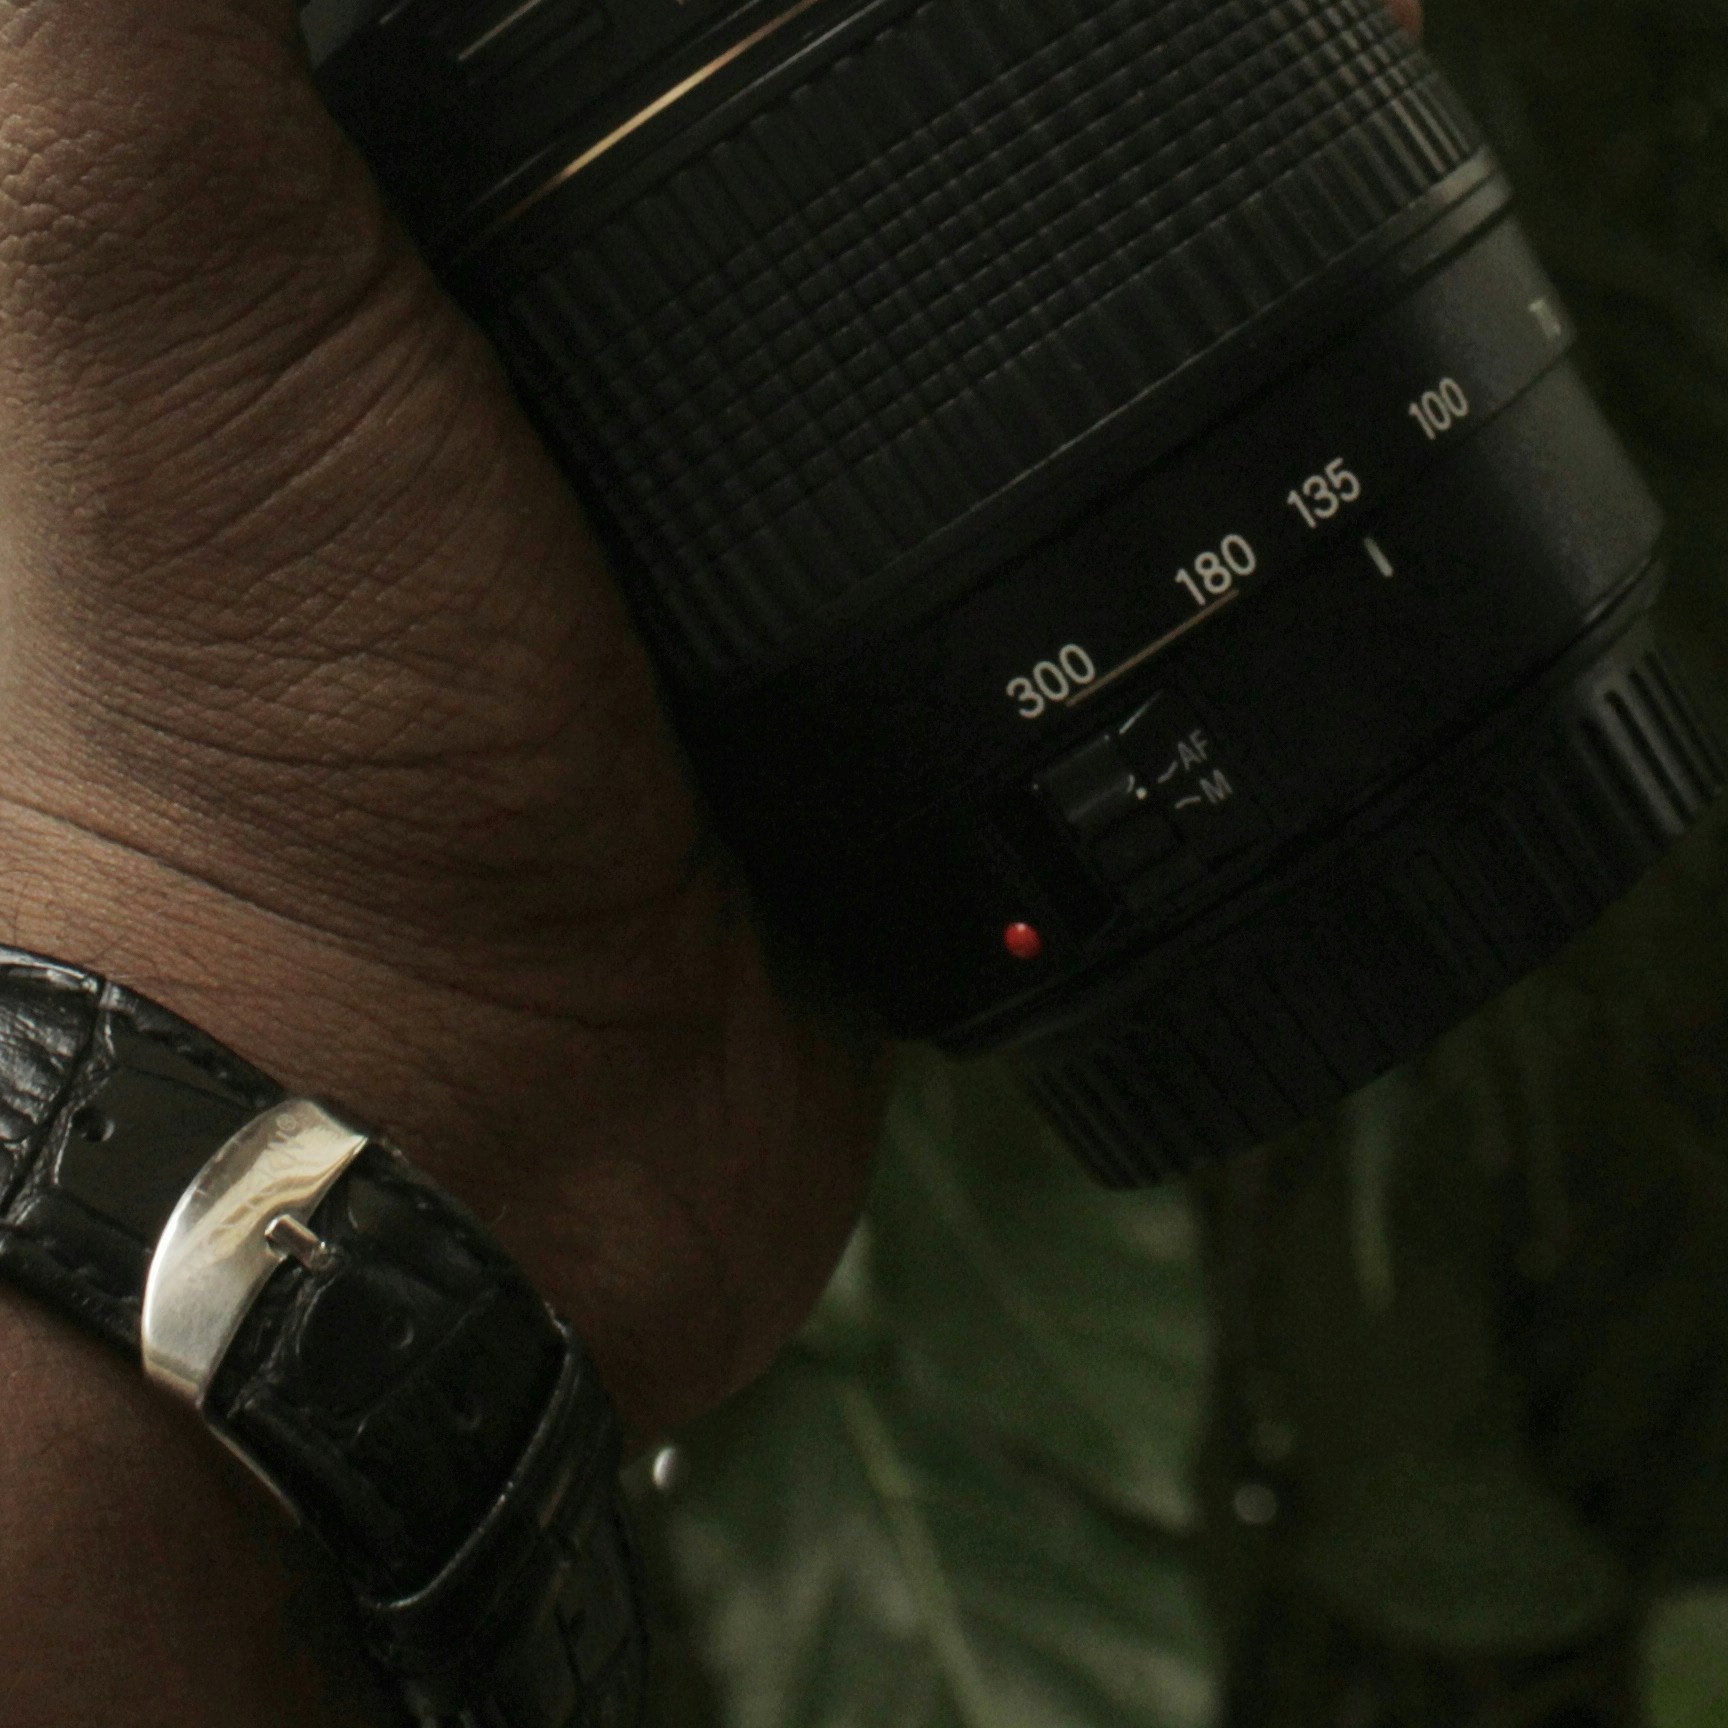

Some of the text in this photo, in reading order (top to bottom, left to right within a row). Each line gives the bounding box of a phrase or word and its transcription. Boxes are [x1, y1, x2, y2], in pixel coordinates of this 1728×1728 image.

[1005, 376, 1471, 721] 300 180 135 100
[1177, 729, 1208, 770] AF
[1198, 769, 1234, 804] M
